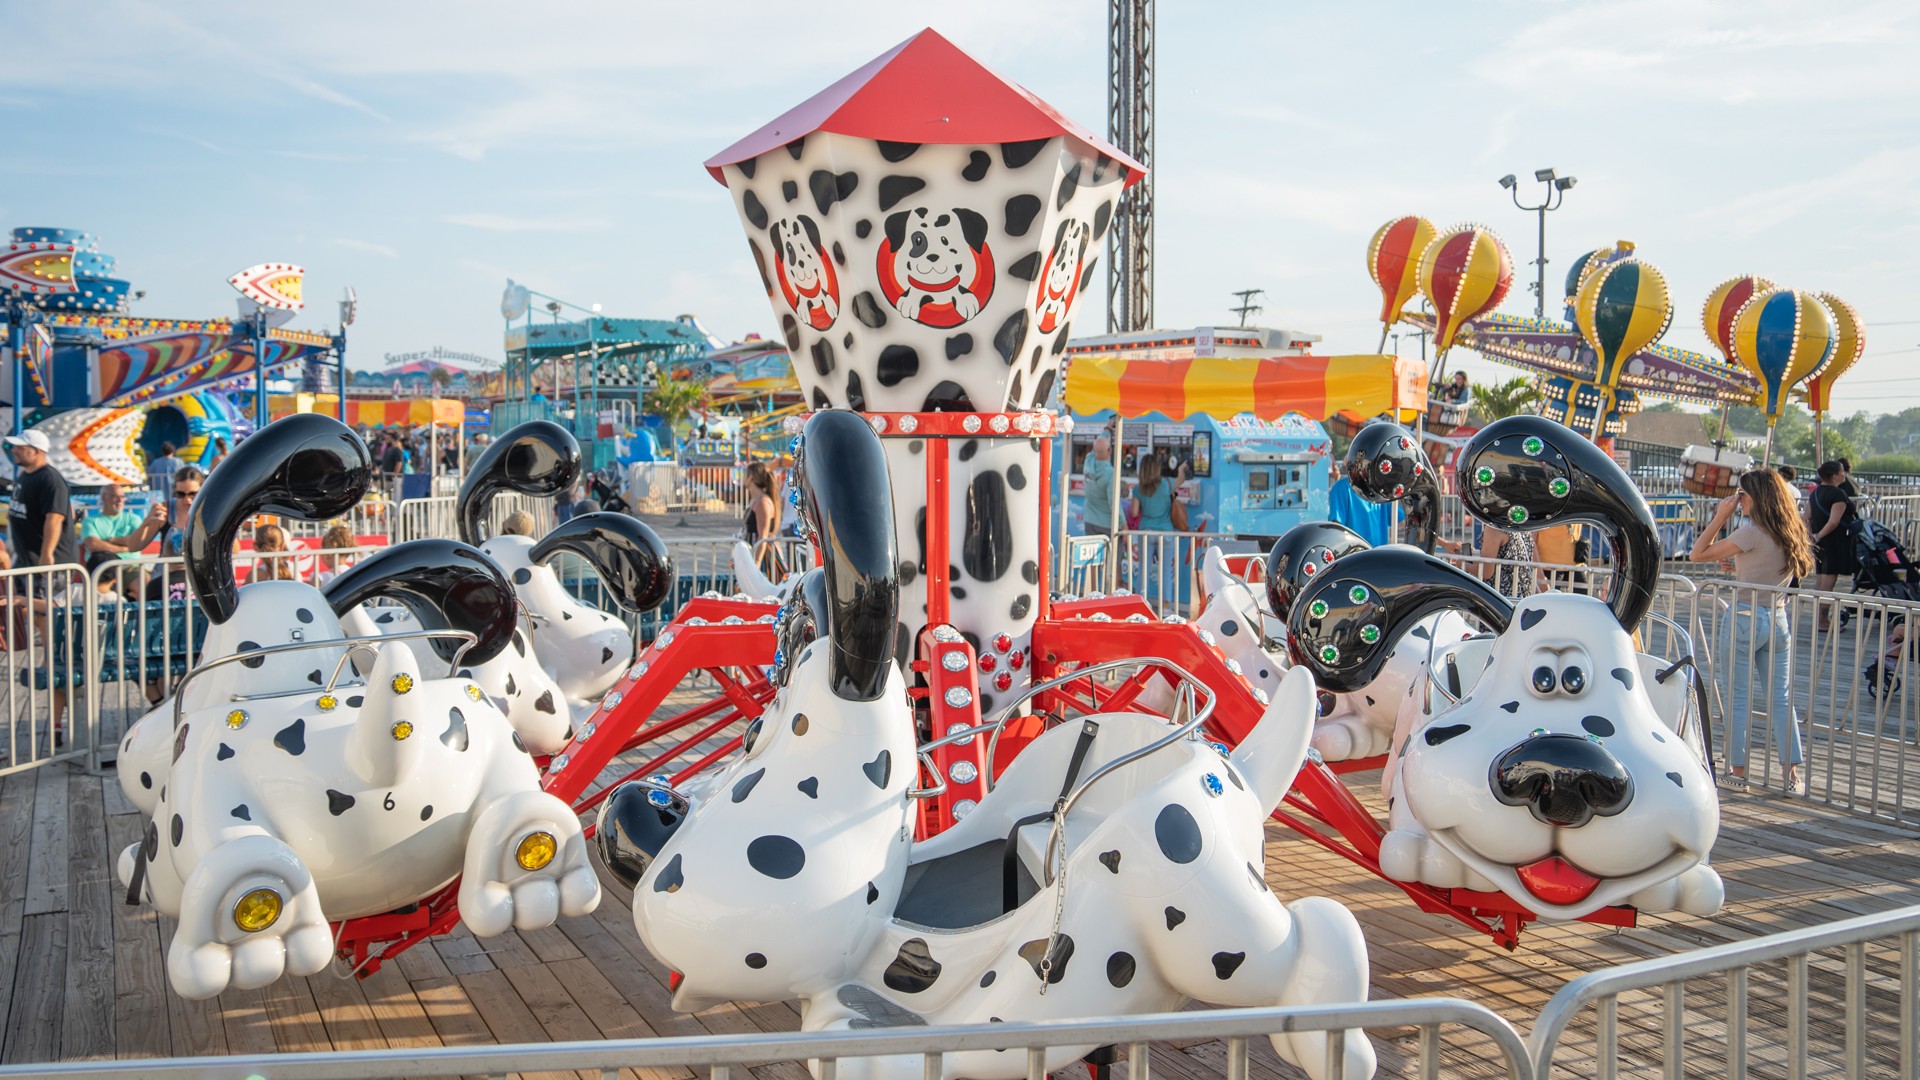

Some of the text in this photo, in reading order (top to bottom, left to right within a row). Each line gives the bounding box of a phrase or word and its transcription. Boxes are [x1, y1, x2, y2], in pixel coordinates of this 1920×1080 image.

[384, 345, 498, 368] Super Himalaya
[1223, 427, 1321, 437] BOARDWALK
[1079, 543, 1100, 561] EXIT
[383, 791, 396, 811] 6
